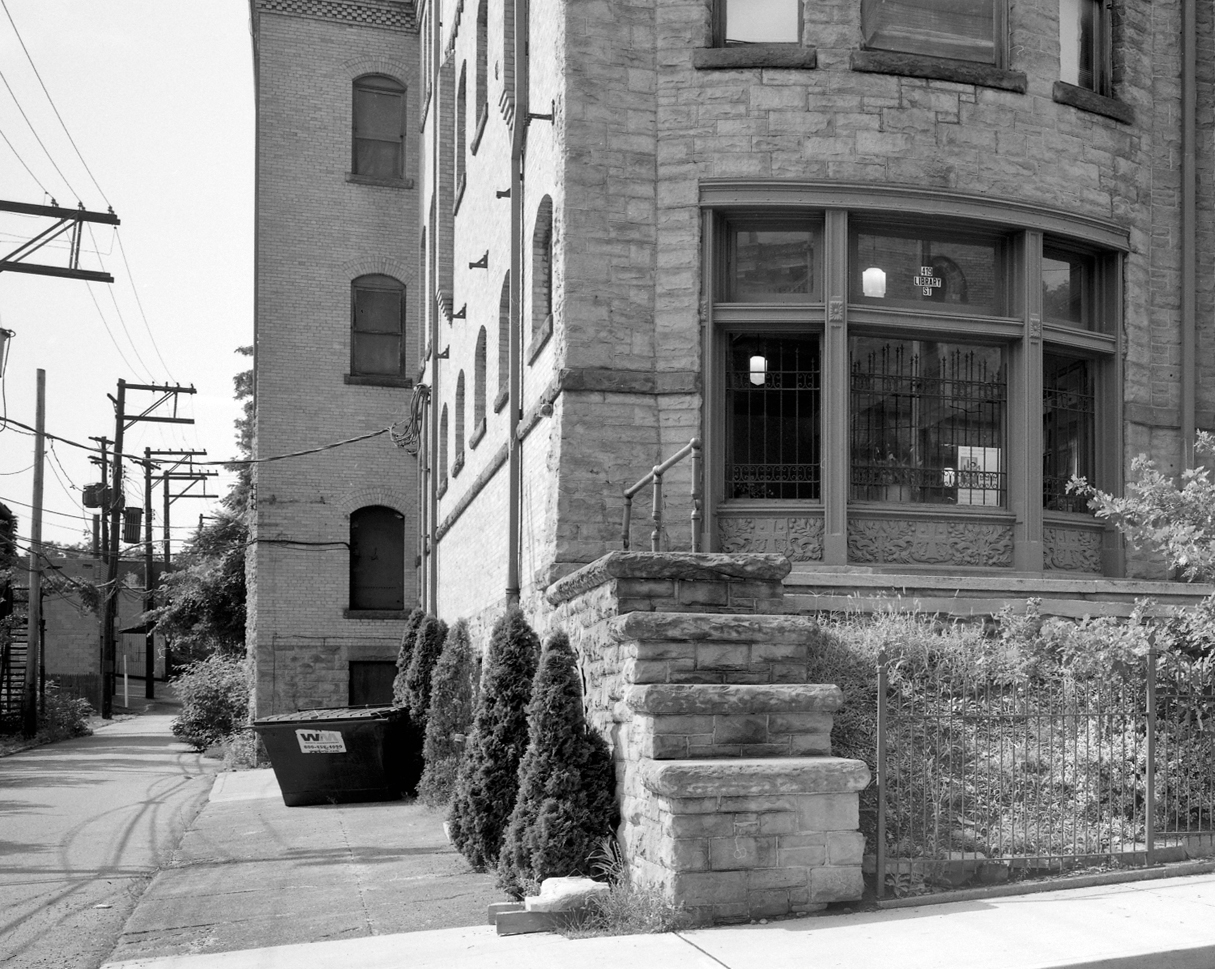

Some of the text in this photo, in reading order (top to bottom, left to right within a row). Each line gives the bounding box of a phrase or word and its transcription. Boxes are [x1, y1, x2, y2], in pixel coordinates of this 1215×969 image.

[914, 277, 941, 287] LIBRARY
[923, 287, 932, 296] ST
[300, 733, 339, 742] WM
